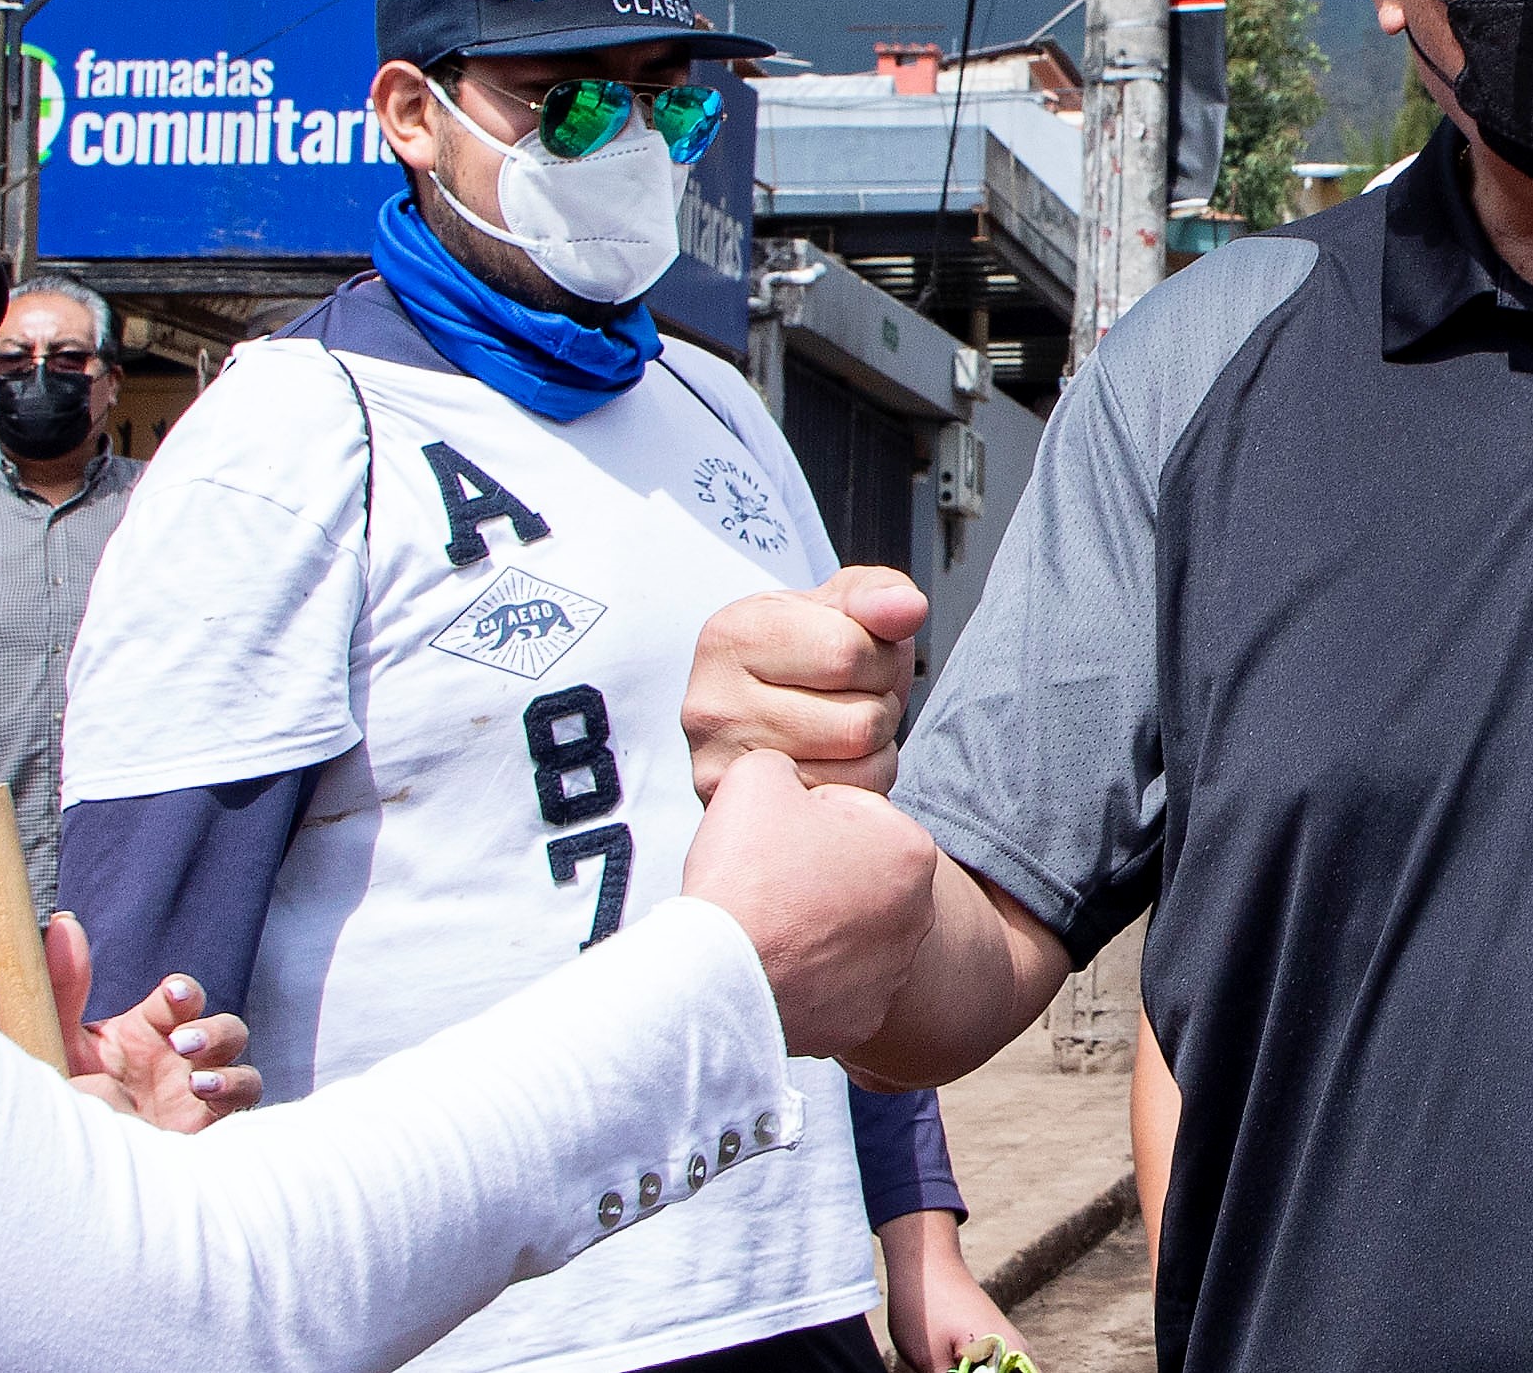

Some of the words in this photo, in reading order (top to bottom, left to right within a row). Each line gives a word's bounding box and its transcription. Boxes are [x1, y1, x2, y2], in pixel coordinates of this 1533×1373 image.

[74, 48, 275, 99] farmacias
[69, 98, 400, 166] comunitari
[420, 440, 552, 567] A
[507, 602, 553, 627] AERO
